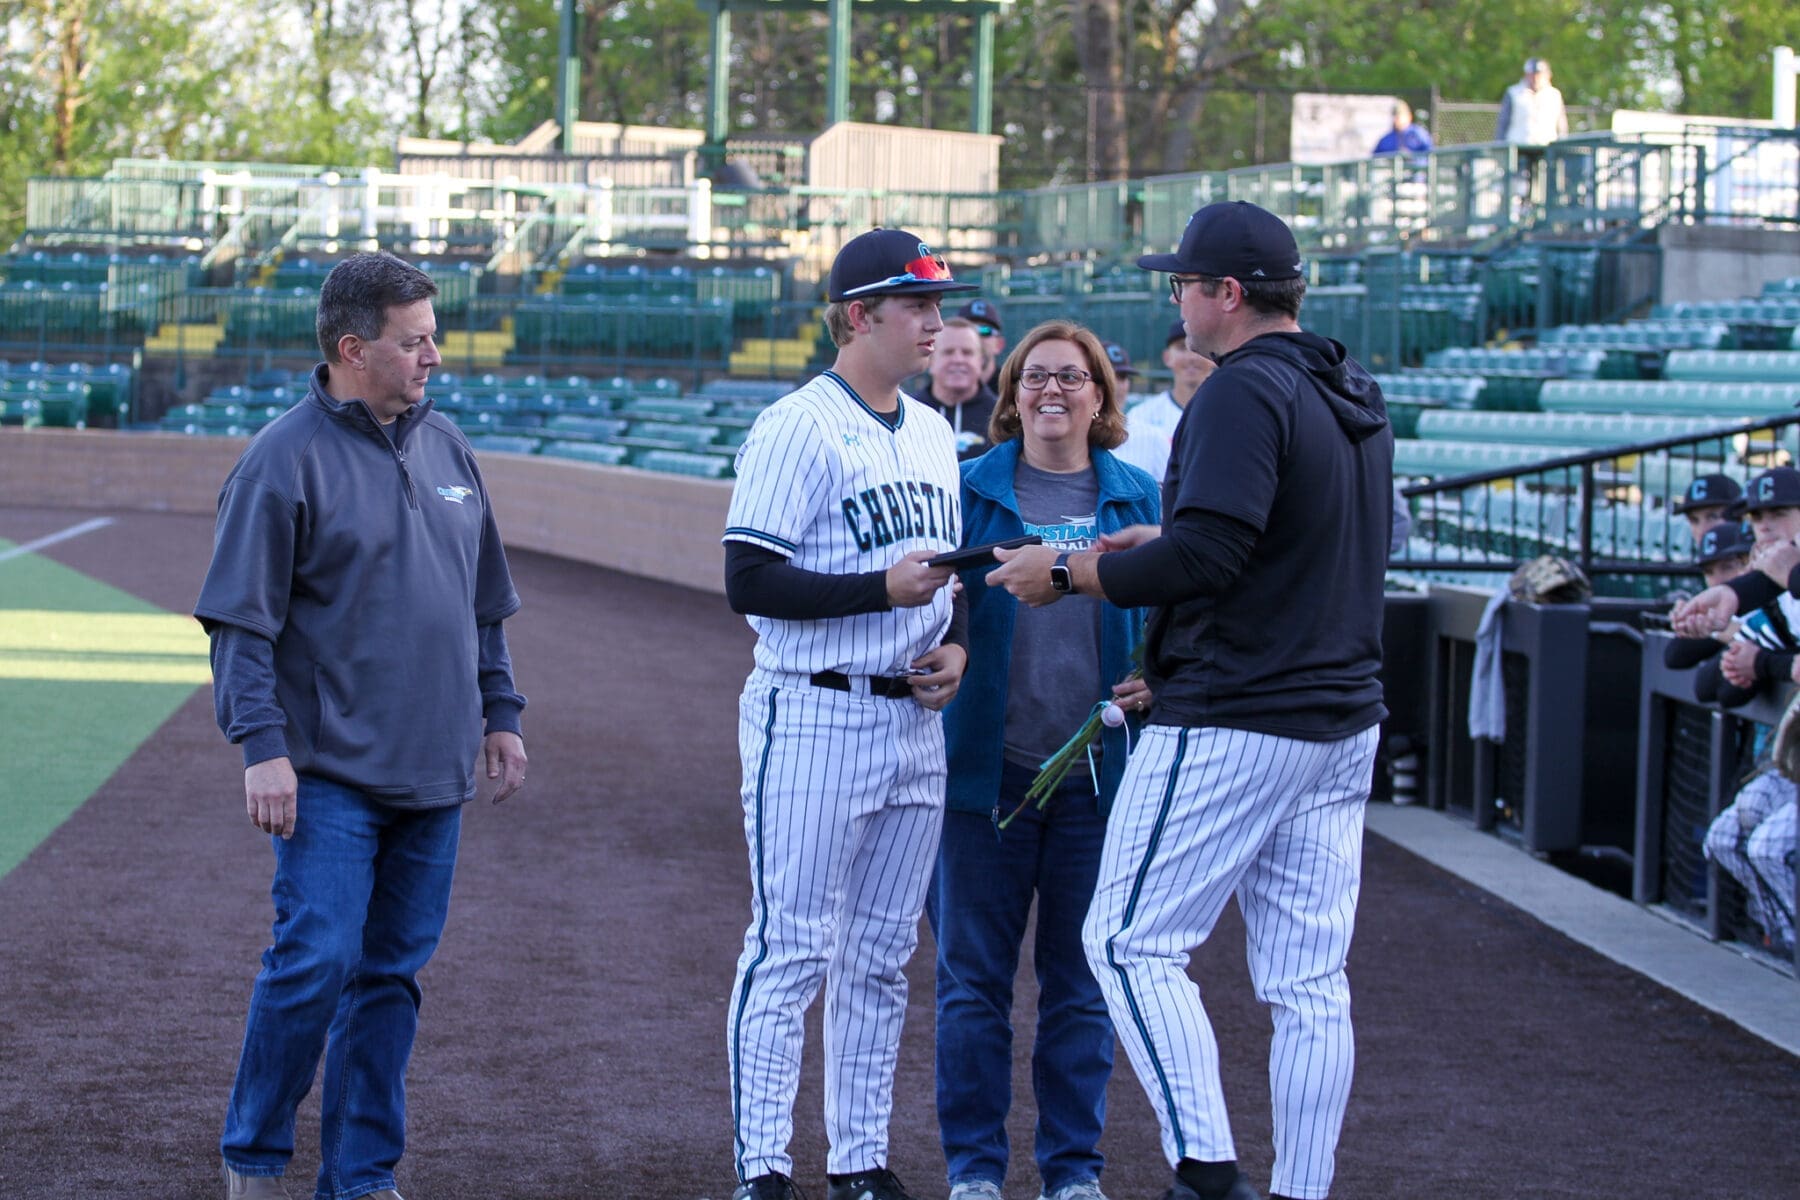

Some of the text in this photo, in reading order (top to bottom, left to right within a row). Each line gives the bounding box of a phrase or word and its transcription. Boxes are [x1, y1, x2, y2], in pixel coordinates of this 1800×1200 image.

[1691, 479, 1707, 500] C
[1759, 476, 1775, 500] C
[841, 480, 959, 553] CHRISTIA
[1703, 531, 1717, 555] C
